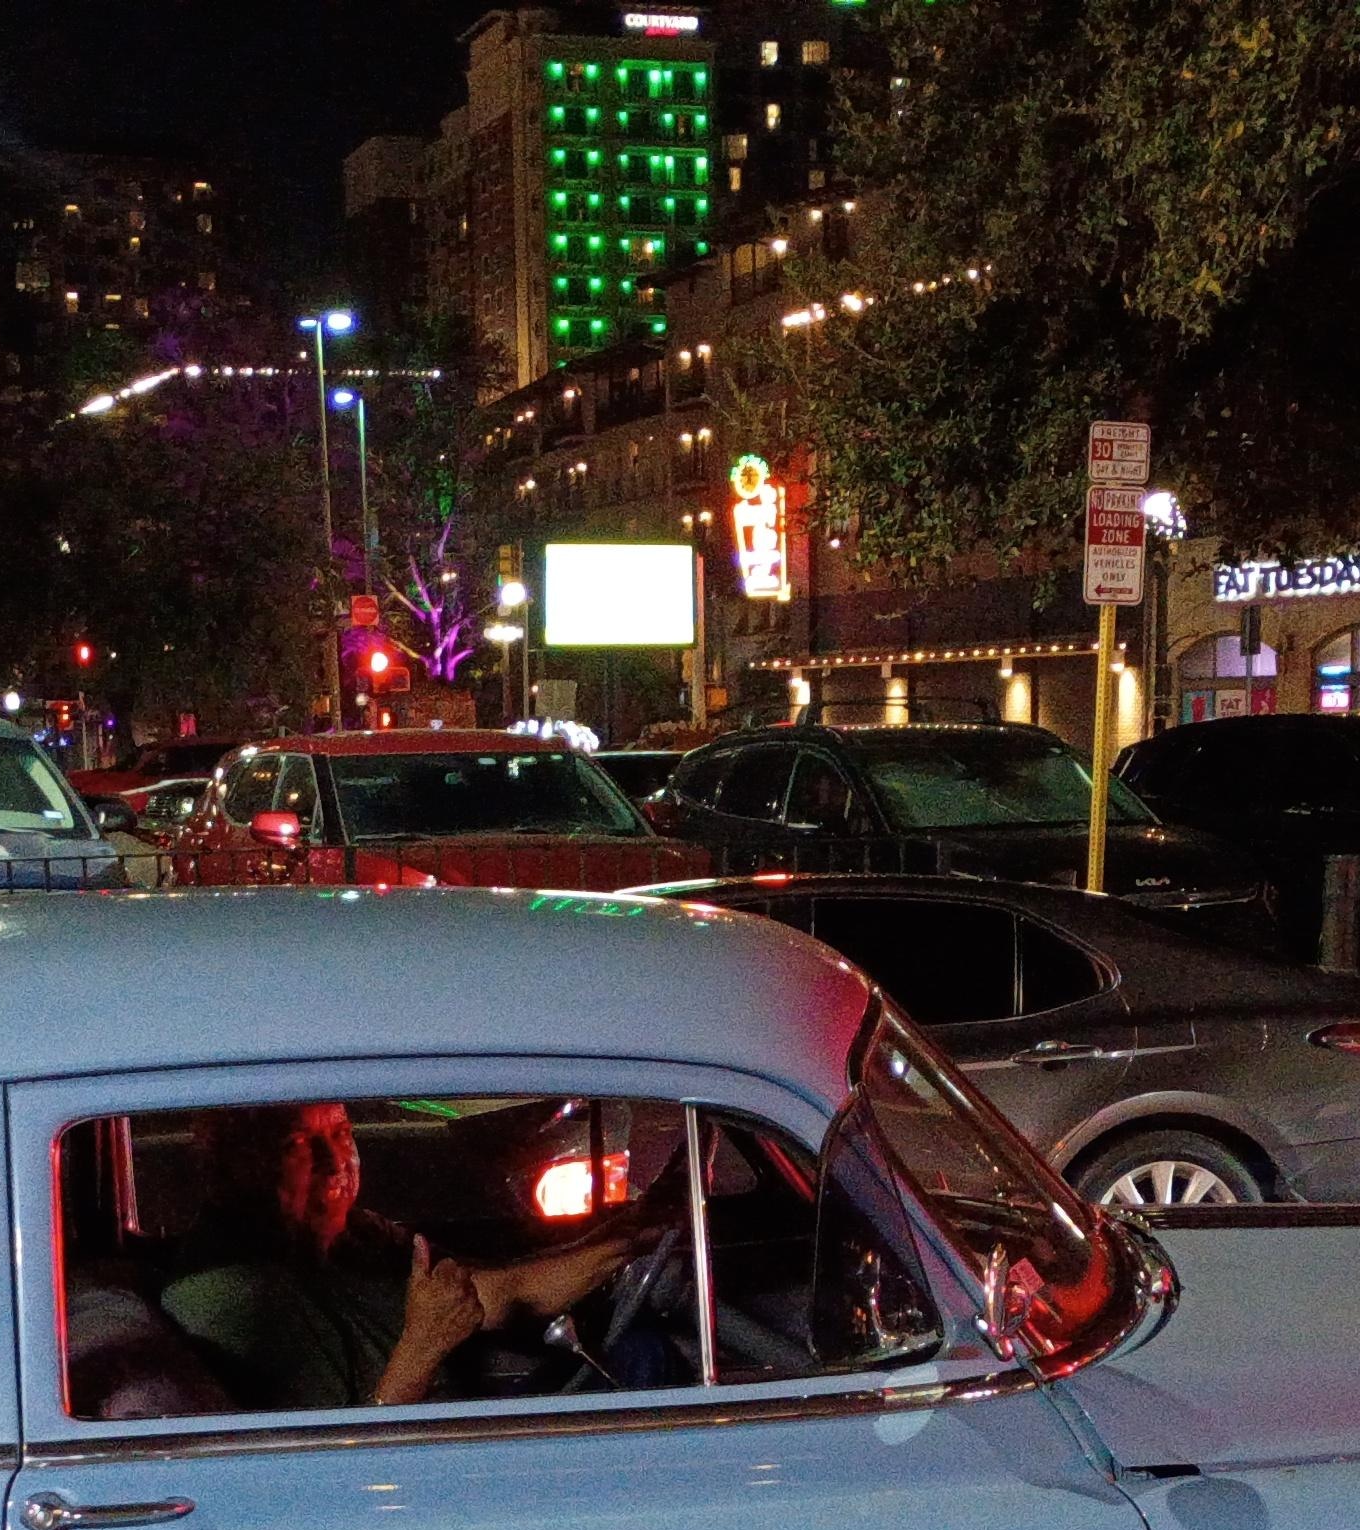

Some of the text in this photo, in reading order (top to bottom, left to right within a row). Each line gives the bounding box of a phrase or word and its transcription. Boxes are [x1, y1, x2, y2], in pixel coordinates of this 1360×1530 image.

[1094, 441, 1111, 458] 30
[1093, 513, 1140, 528] LOADING
[1101, 530, 1131, 543] ZONE
[1094, 559, 1136, 569] VEHICLES
[1102, 572, 1126, 582] ONLY
[1213, 566, 1256, 599] FAT
[1220, 698, 1242, 710] FAT
